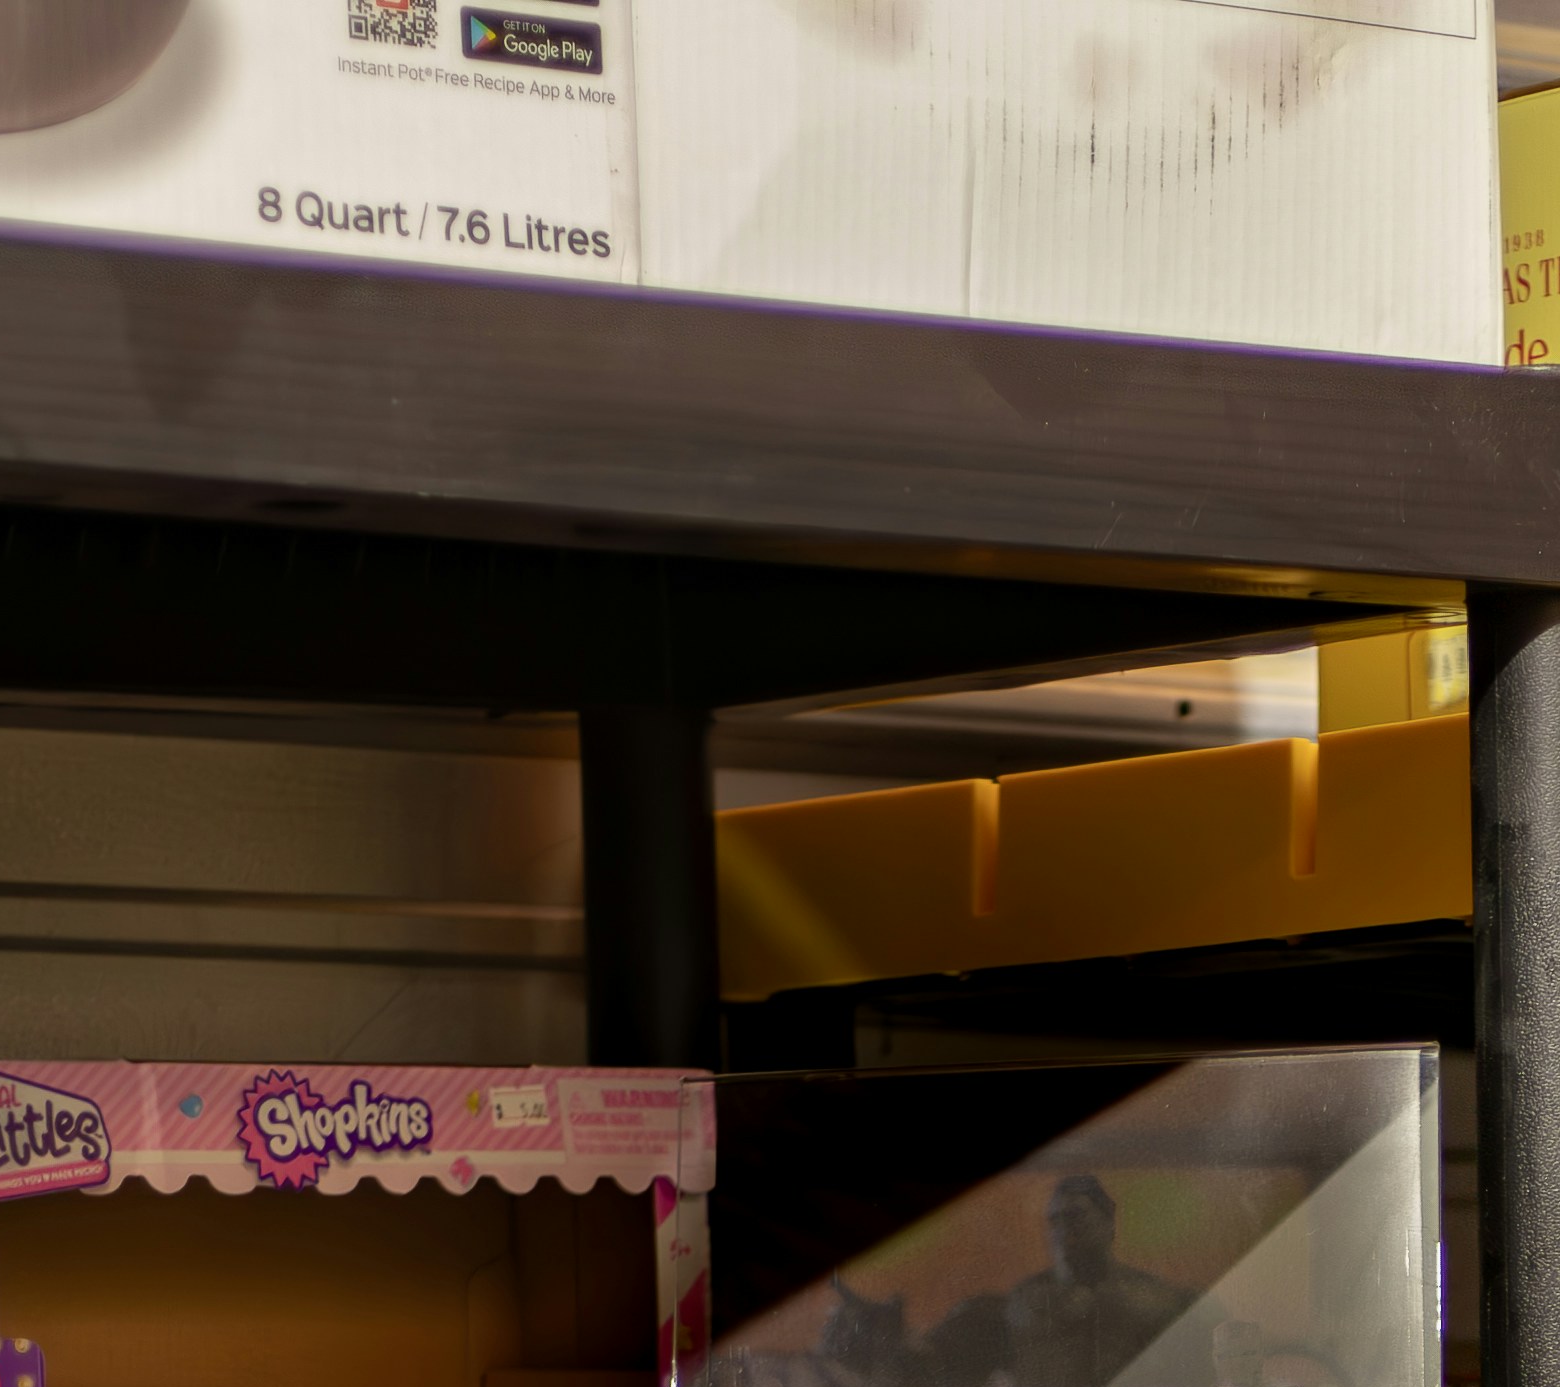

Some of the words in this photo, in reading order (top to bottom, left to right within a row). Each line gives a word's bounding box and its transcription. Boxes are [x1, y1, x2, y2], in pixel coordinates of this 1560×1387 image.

[503, 20, 520, 30] GET
[528, 23, 545, 34] ON
[503, 34, 559, 62] Google
[562, 41, 593, 66] Play
[338, 56, 394, 79] Instant
[435, 68, 470, 87] Free
[474, 73, 525, 95] Recipe
[530, 80, 560, 101] App
[565, 85, 575, 100] &
[579, 88, 616, 105] More
[258, 186, 283, 224] 8
[295, 190, 410, 238] Quart
[437, 204, 492, 246] 7.6
[503, 212, 612, 259] Litres
[257, 1082, 430, 1160] Shopkins
